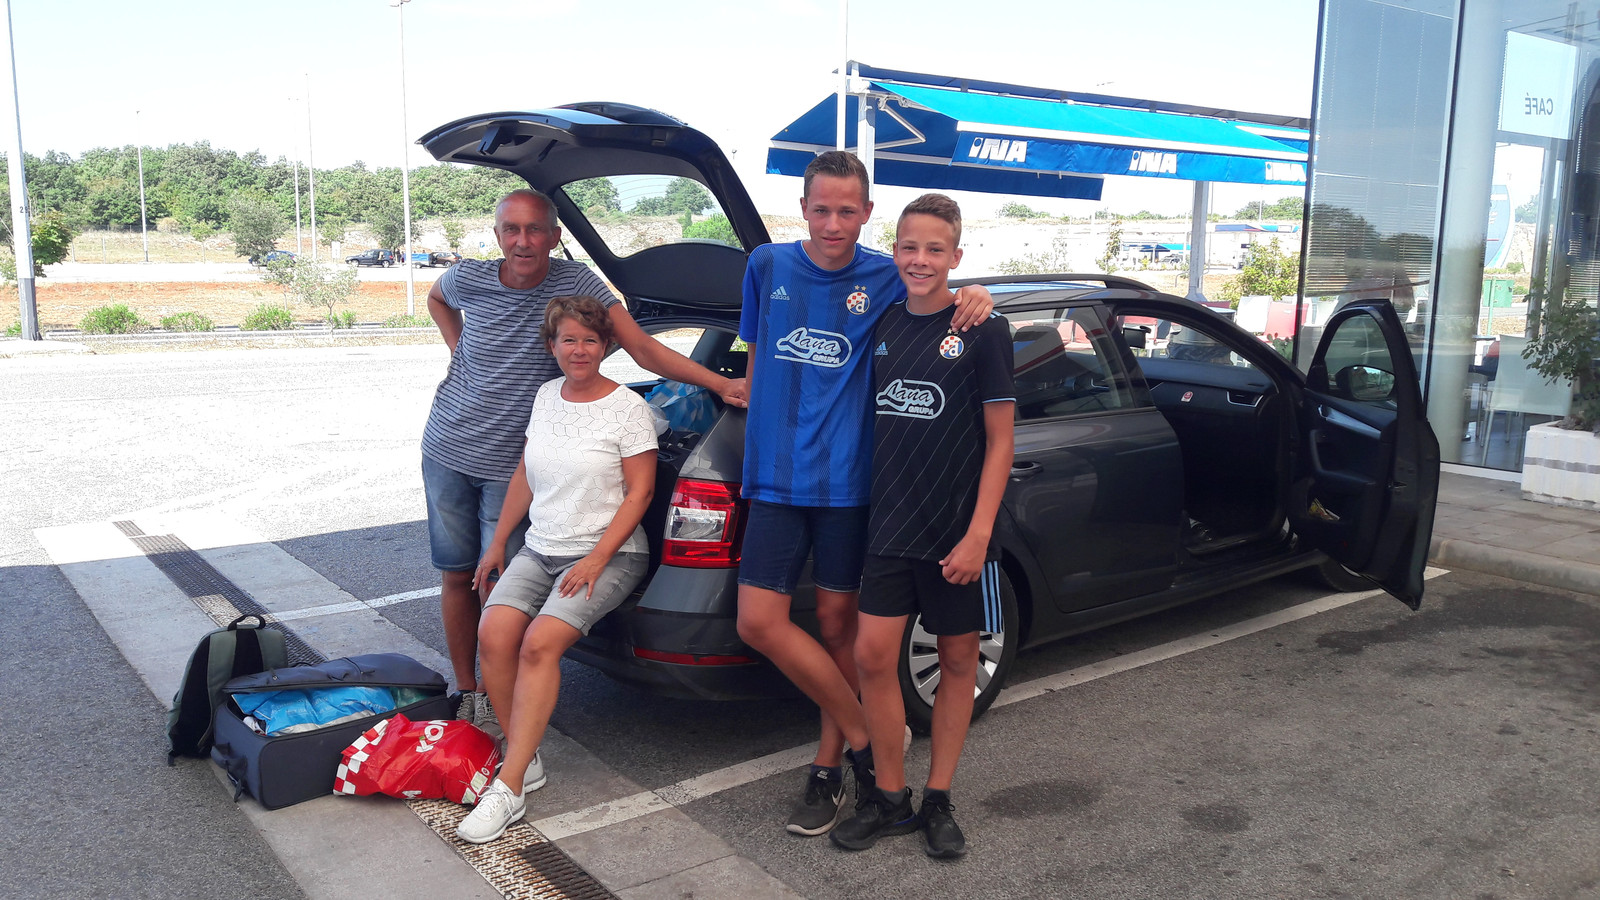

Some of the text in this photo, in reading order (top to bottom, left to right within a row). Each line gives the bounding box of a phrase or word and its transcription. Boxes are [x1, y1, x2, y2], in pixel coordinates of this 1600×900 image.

[968, 137, 1028, 163] INA
[1128, 150, 1177, 174] INA
[812, 354, 840, 364] GRUPA
[907, 406, 934, 416] GRUPA
